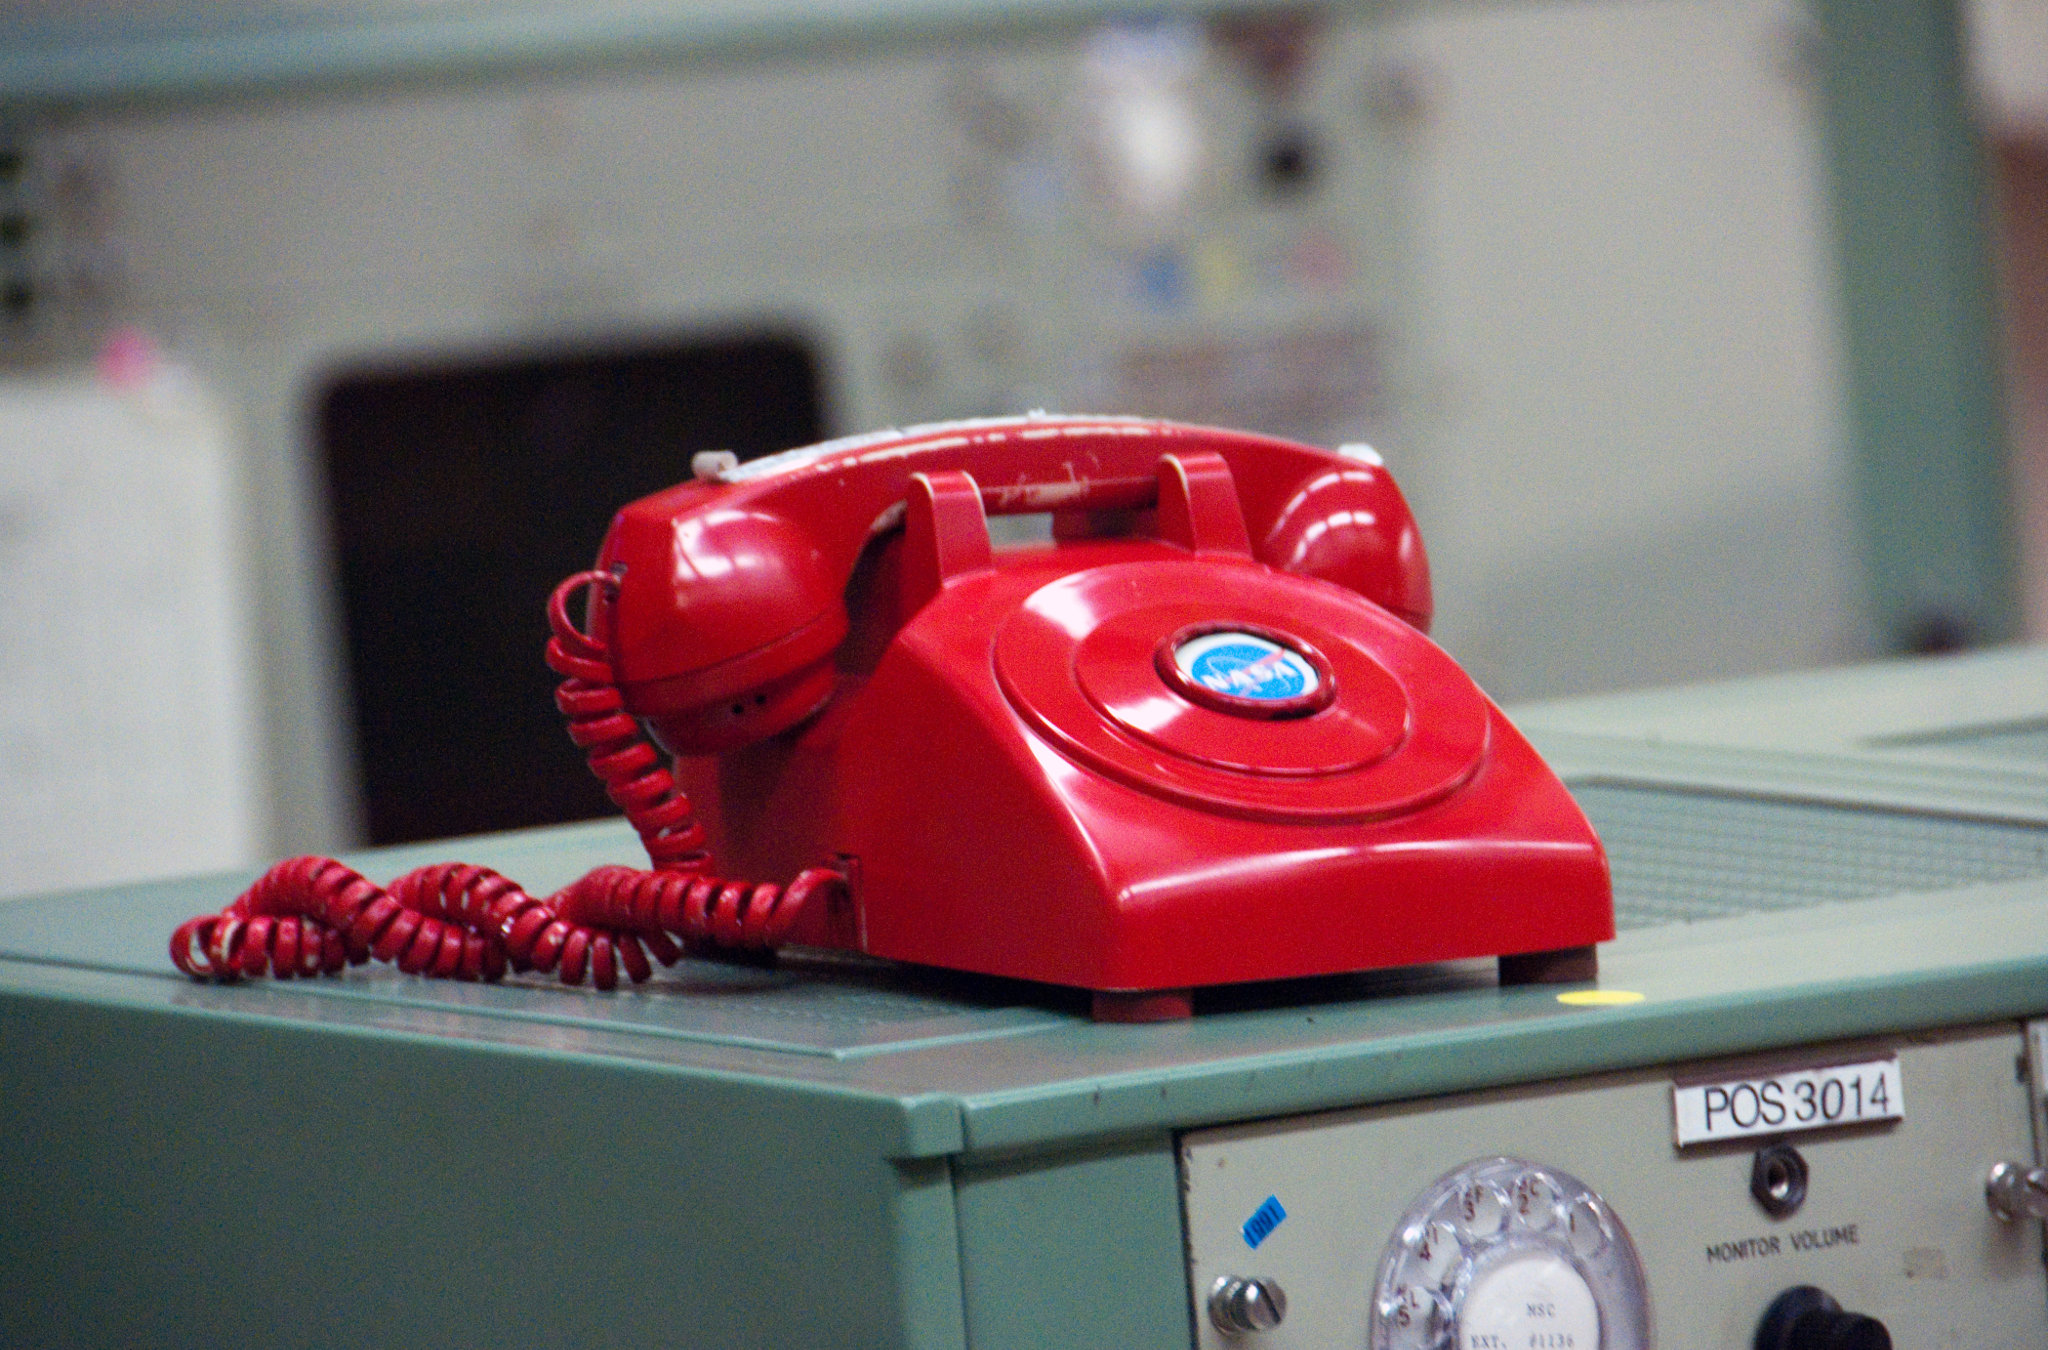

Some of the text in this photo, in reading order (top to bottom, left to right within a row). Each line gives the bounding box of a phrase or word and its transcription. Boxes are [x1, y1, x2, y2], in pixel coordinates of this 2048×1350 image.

[1201, 660, 1298, 692] NASA
[1706, 1223, 1860, 1264] MONITOR VOLUME
